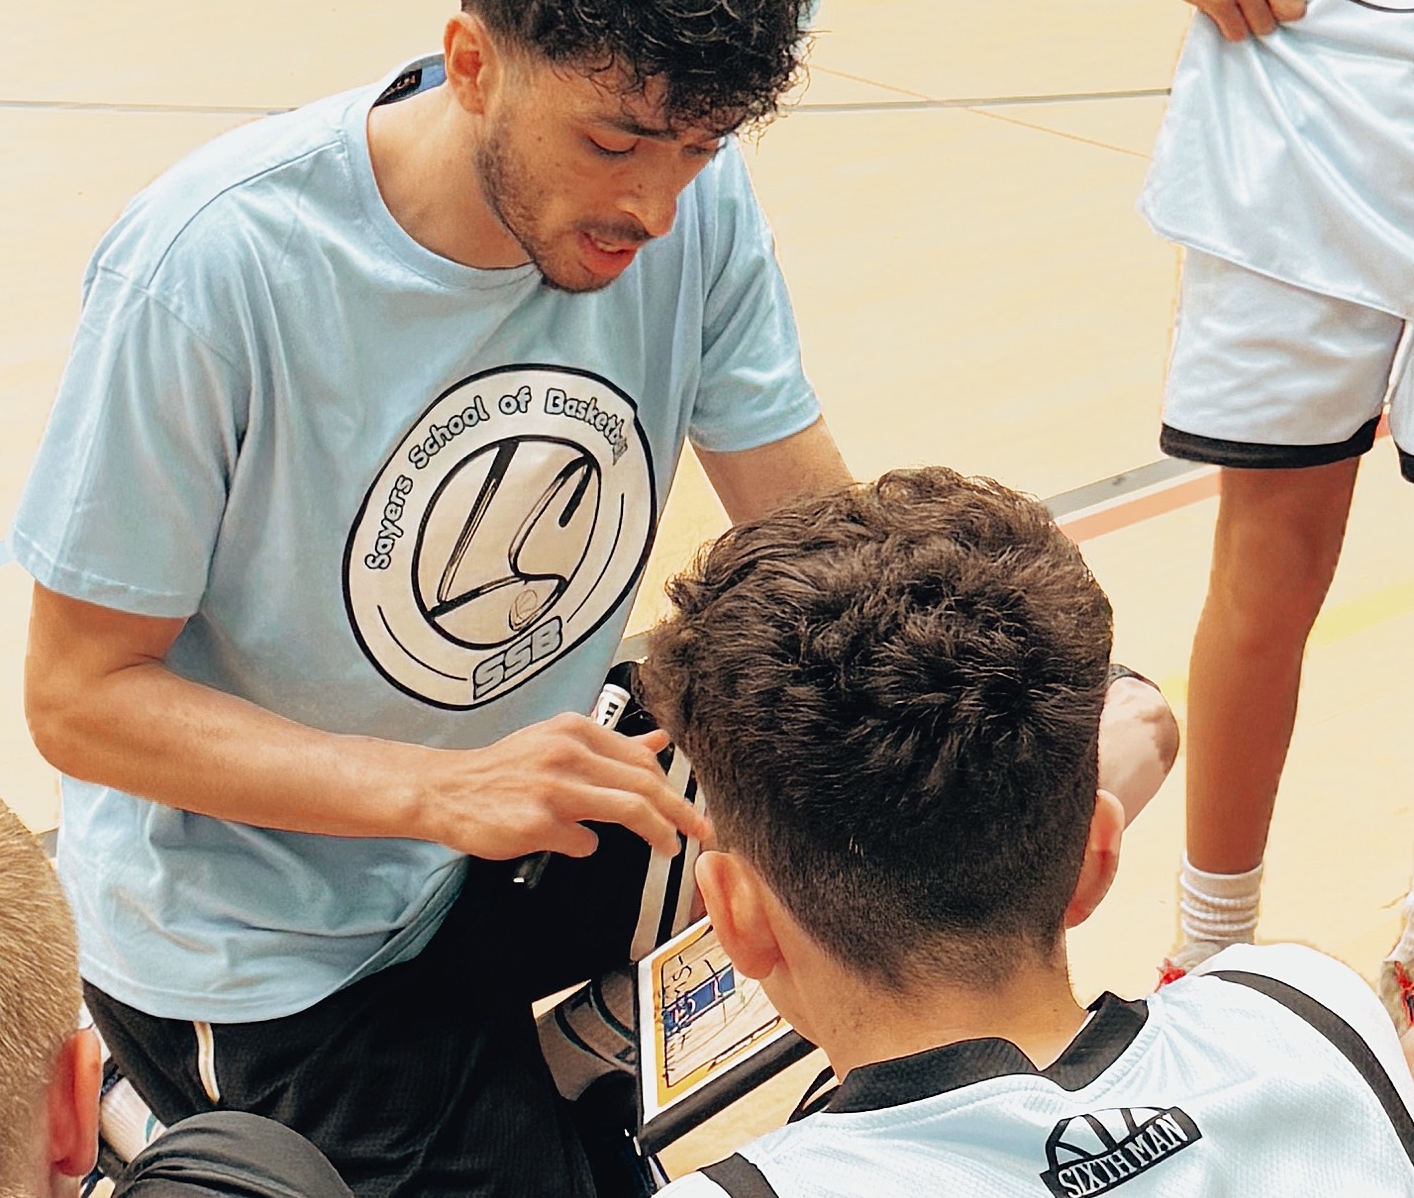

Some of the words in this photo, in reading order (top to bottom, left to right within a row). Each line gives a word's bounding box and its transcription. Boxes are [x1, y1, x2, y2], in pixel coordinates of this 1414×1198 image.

[364, 474, 413, 570] Sayers
[408, 394, 491, 470] School
[498, 385, 532, 415] of
[472, 615, 563, 701] SSB
[1057, 1149, 1138, 1198] SIXTH
[1124, 1112, 1188, 1167] MAN
